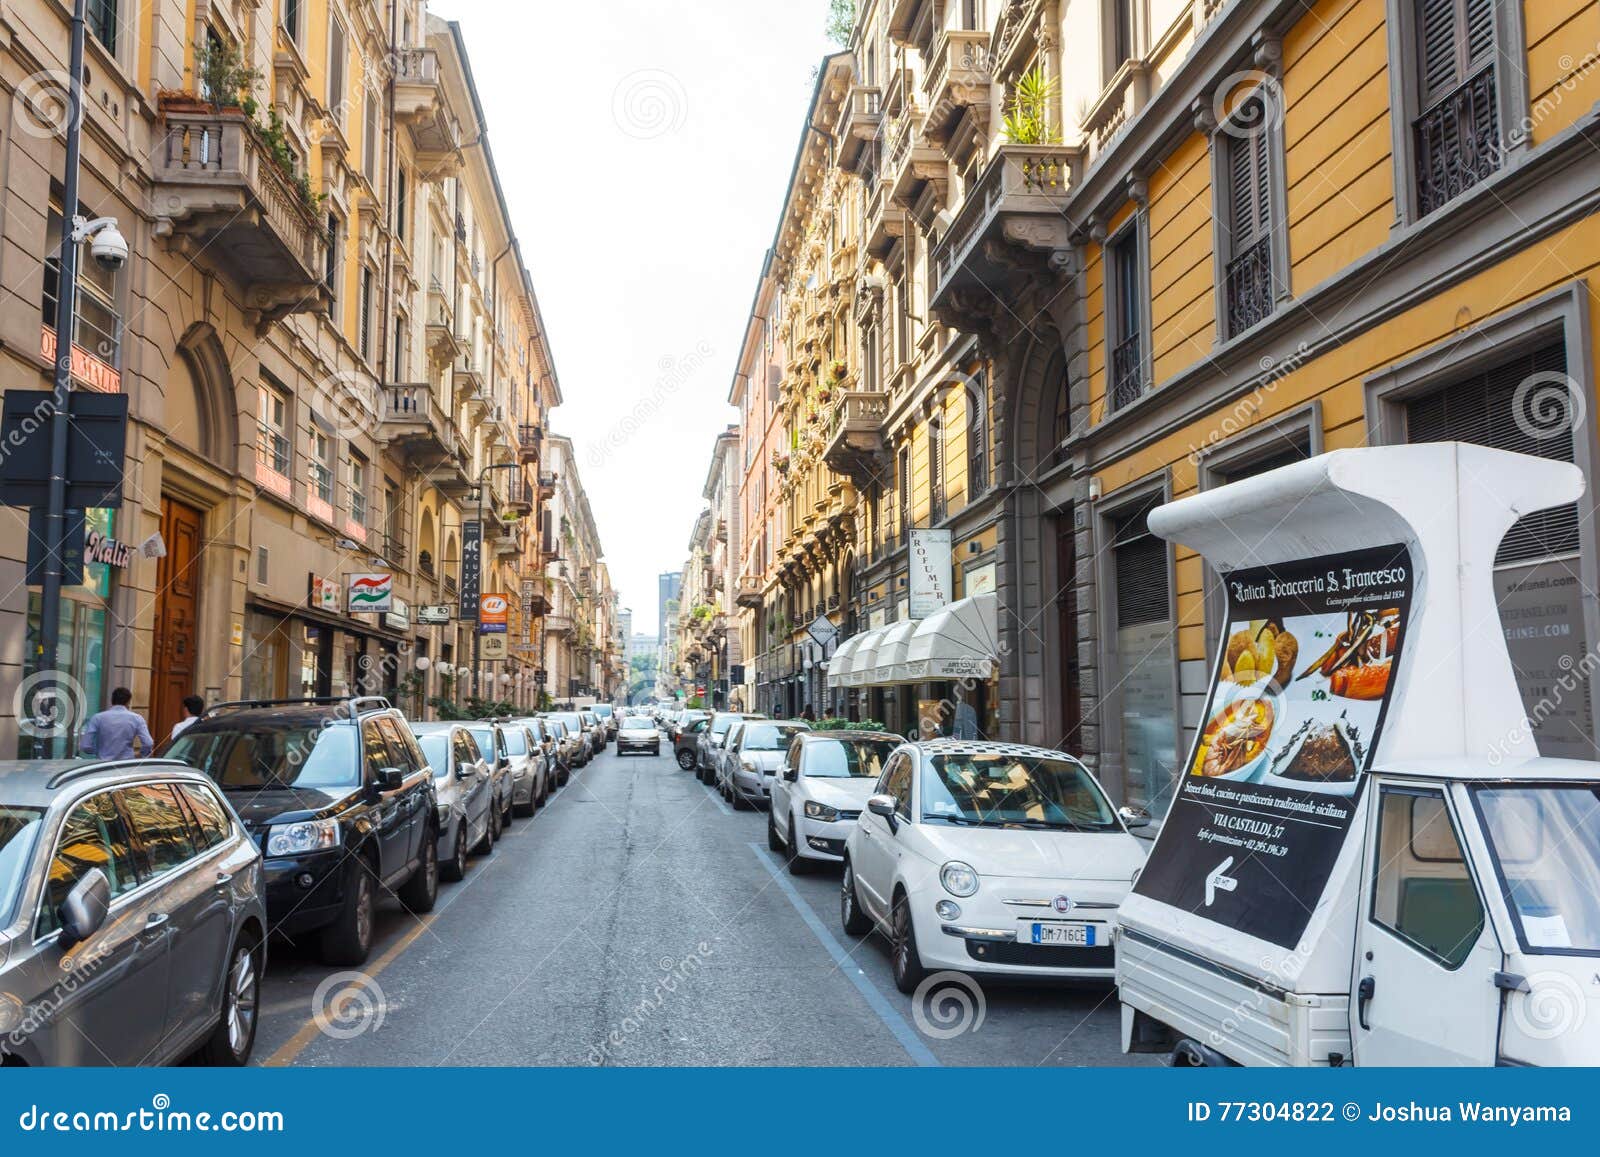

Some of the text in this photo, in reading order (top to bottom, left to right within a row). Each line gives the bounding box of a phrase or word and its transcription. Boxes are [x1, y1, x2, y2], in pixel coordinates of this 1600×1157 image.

[1342, 567, 1406, 590] Francesco
[1213, 813, 1285, 838] VIA CASTALDI, 37
